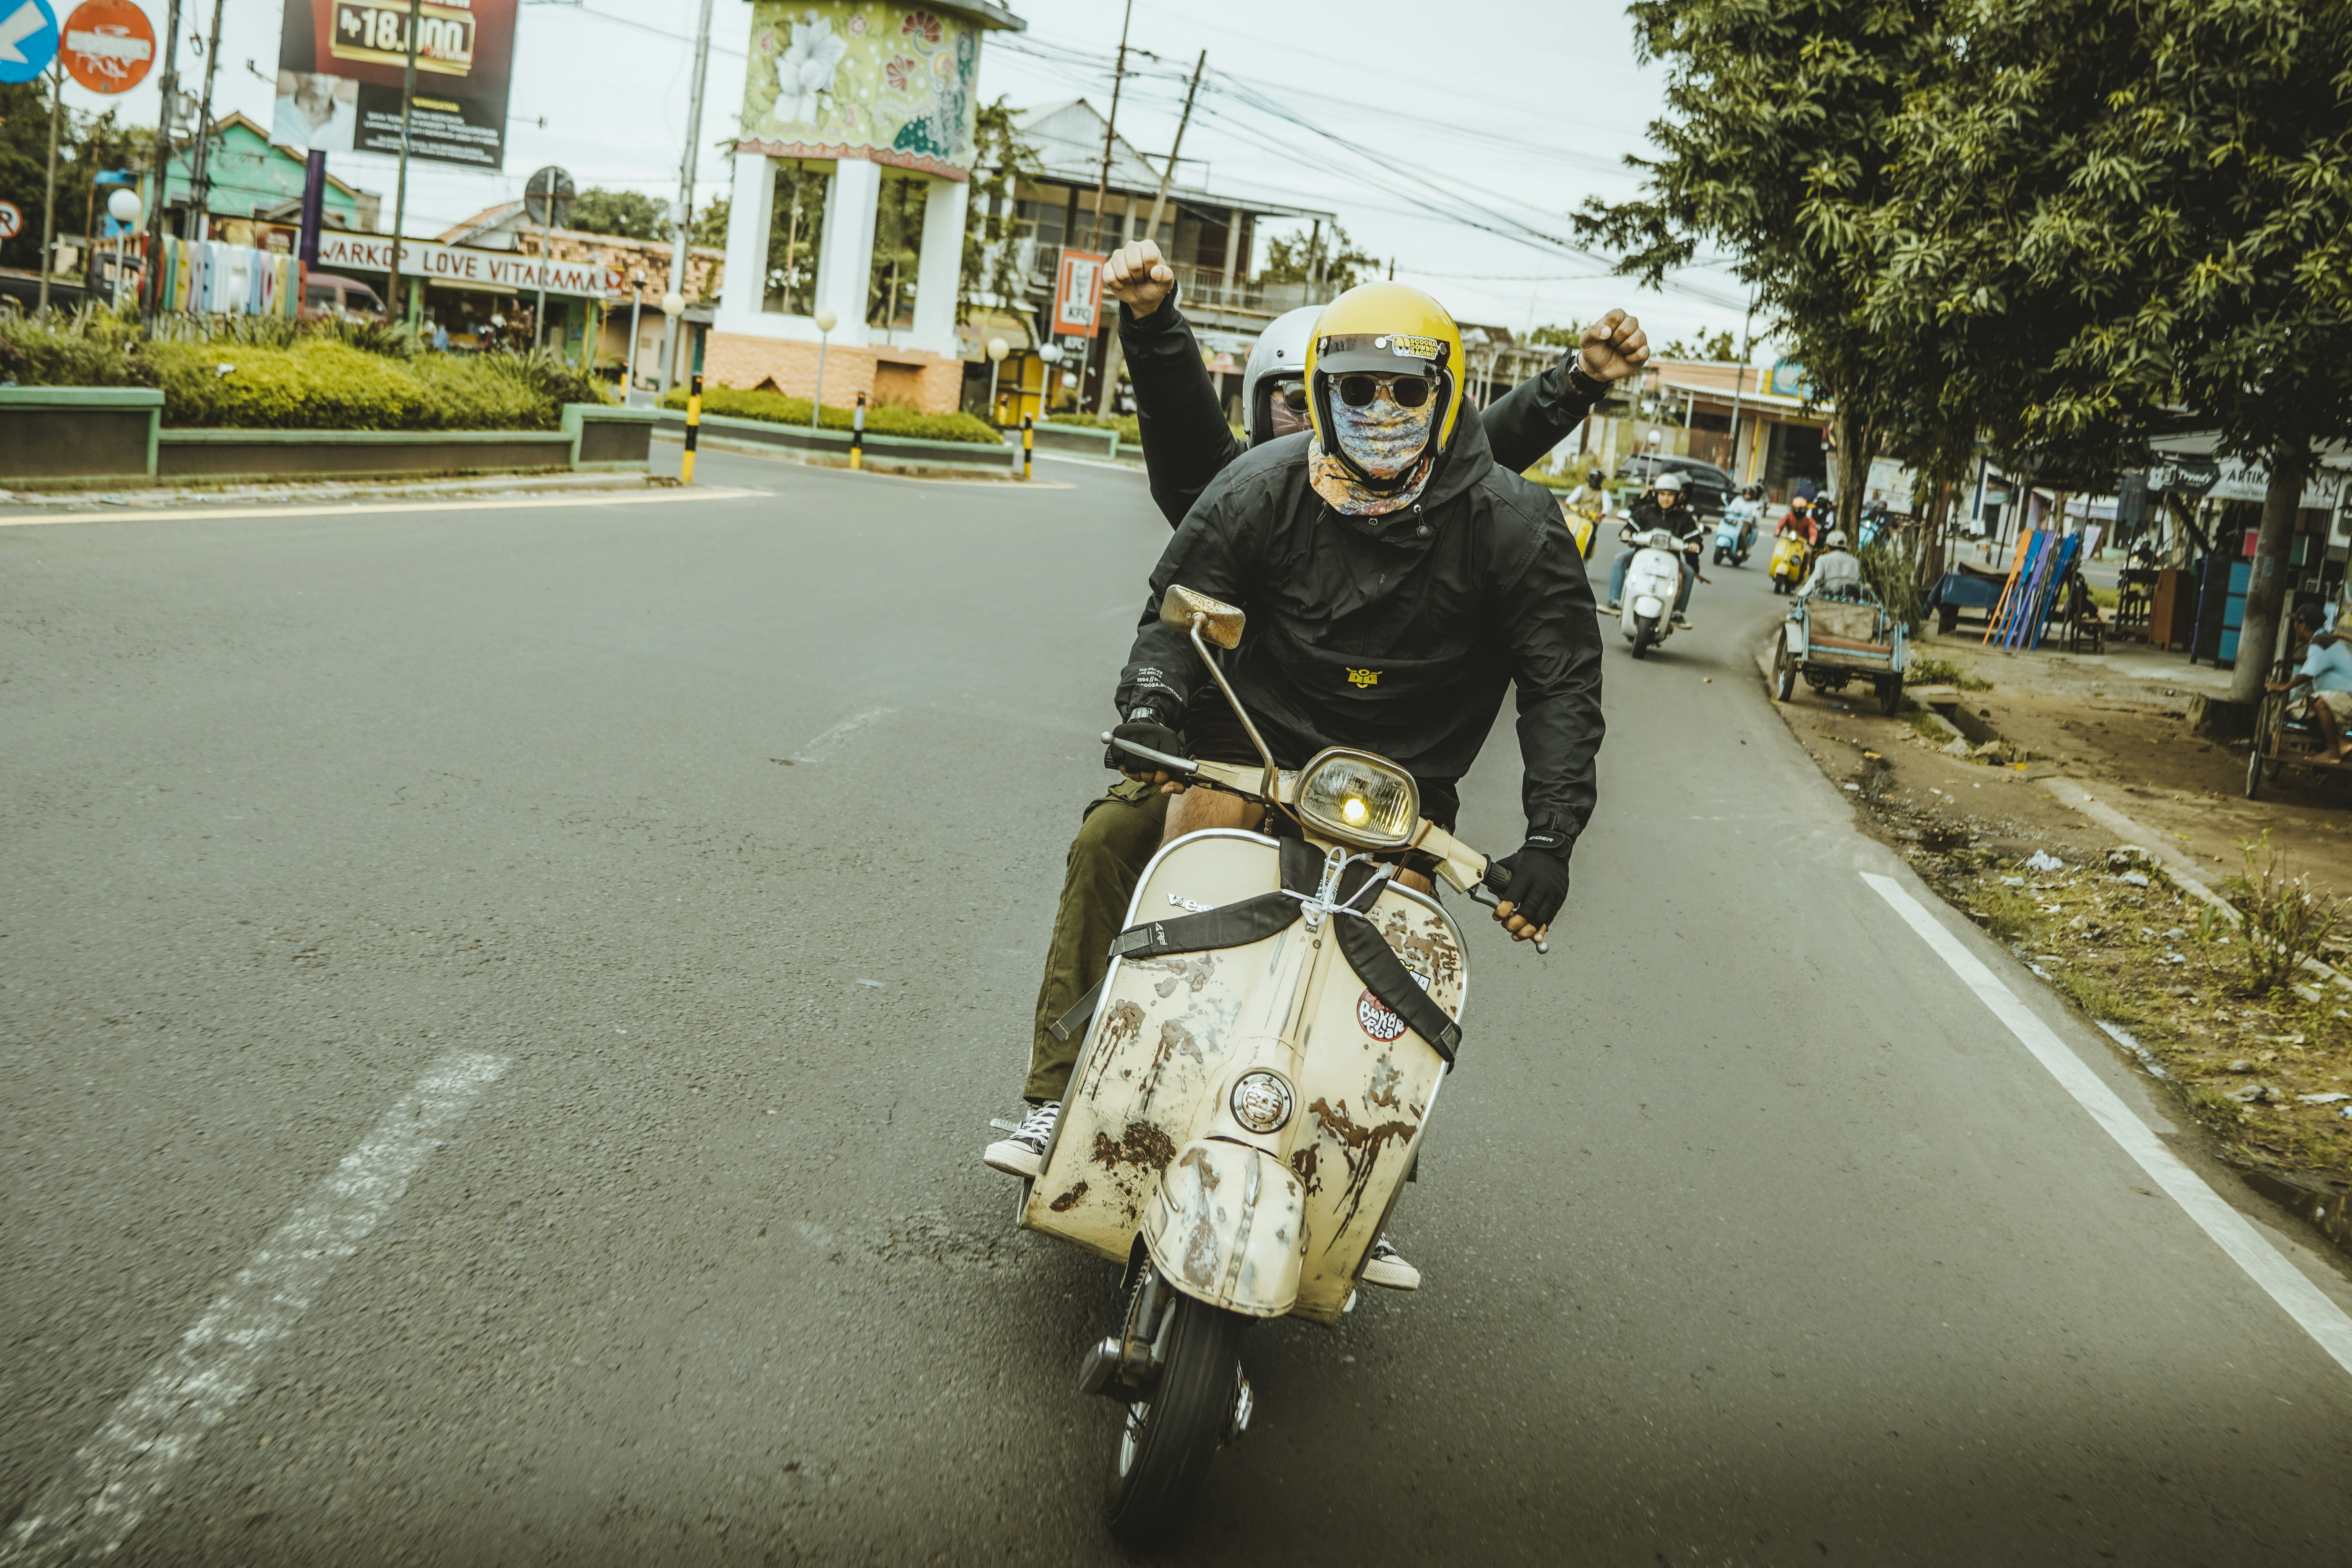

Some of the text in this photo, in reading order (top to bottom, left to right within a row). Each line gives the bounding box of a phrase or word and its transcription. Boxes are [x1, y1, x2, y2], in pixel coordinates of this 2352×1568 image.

[424, 250, 478, 277] LOVE
[1067, 307, 1091, 321] KFC
[1410, 338, 1436, 347] SCOOBA
[1410, 344, 1437, 354] COWBOY
[1410, 349, 1435, 358] RACING
[1147, 667, 1163, 675] RULES
